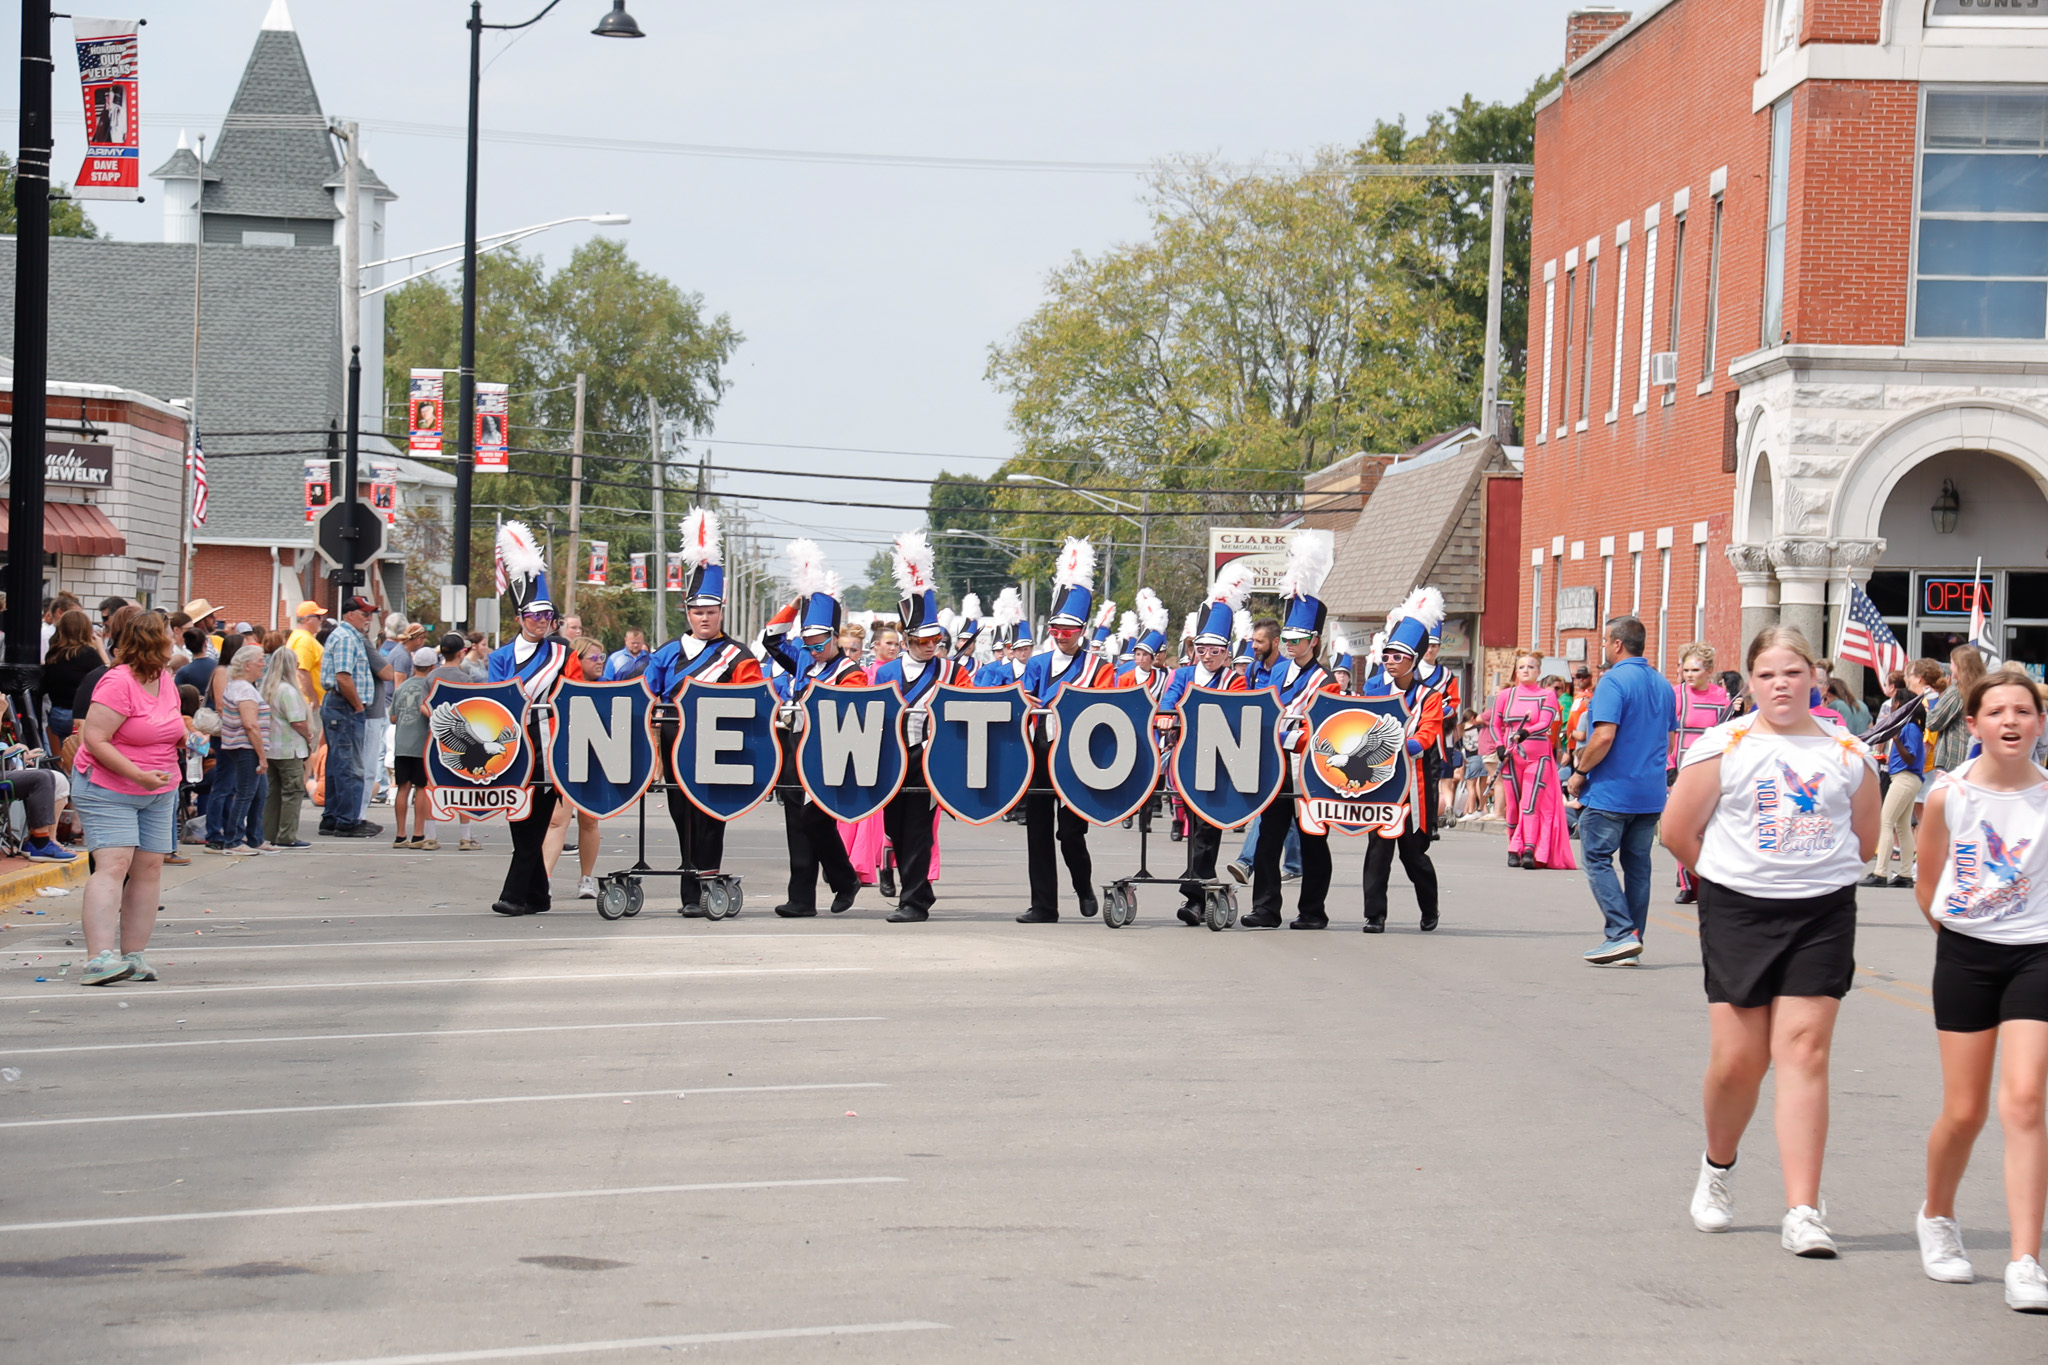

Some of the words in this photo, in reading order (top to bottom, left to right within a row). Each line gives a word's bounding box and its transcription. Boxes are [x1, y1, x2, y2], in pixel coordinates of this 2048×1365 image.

[87, 148, 125, 156] ARMY
[93, 160, 118, 170] DAVE
[91, 171, 121, 182] STAPP
[44, 465, 108, 483] JEWELRY
[1220, 534, 1286, 545] CLARK
[443, 789, 517, 807] ILLINOIS
[1317, 801, 1394, 822] ILLINOIS
[1756, 778, 1778, 851] NEWTON
[1946, 843, 1977, 916] NEWTON
